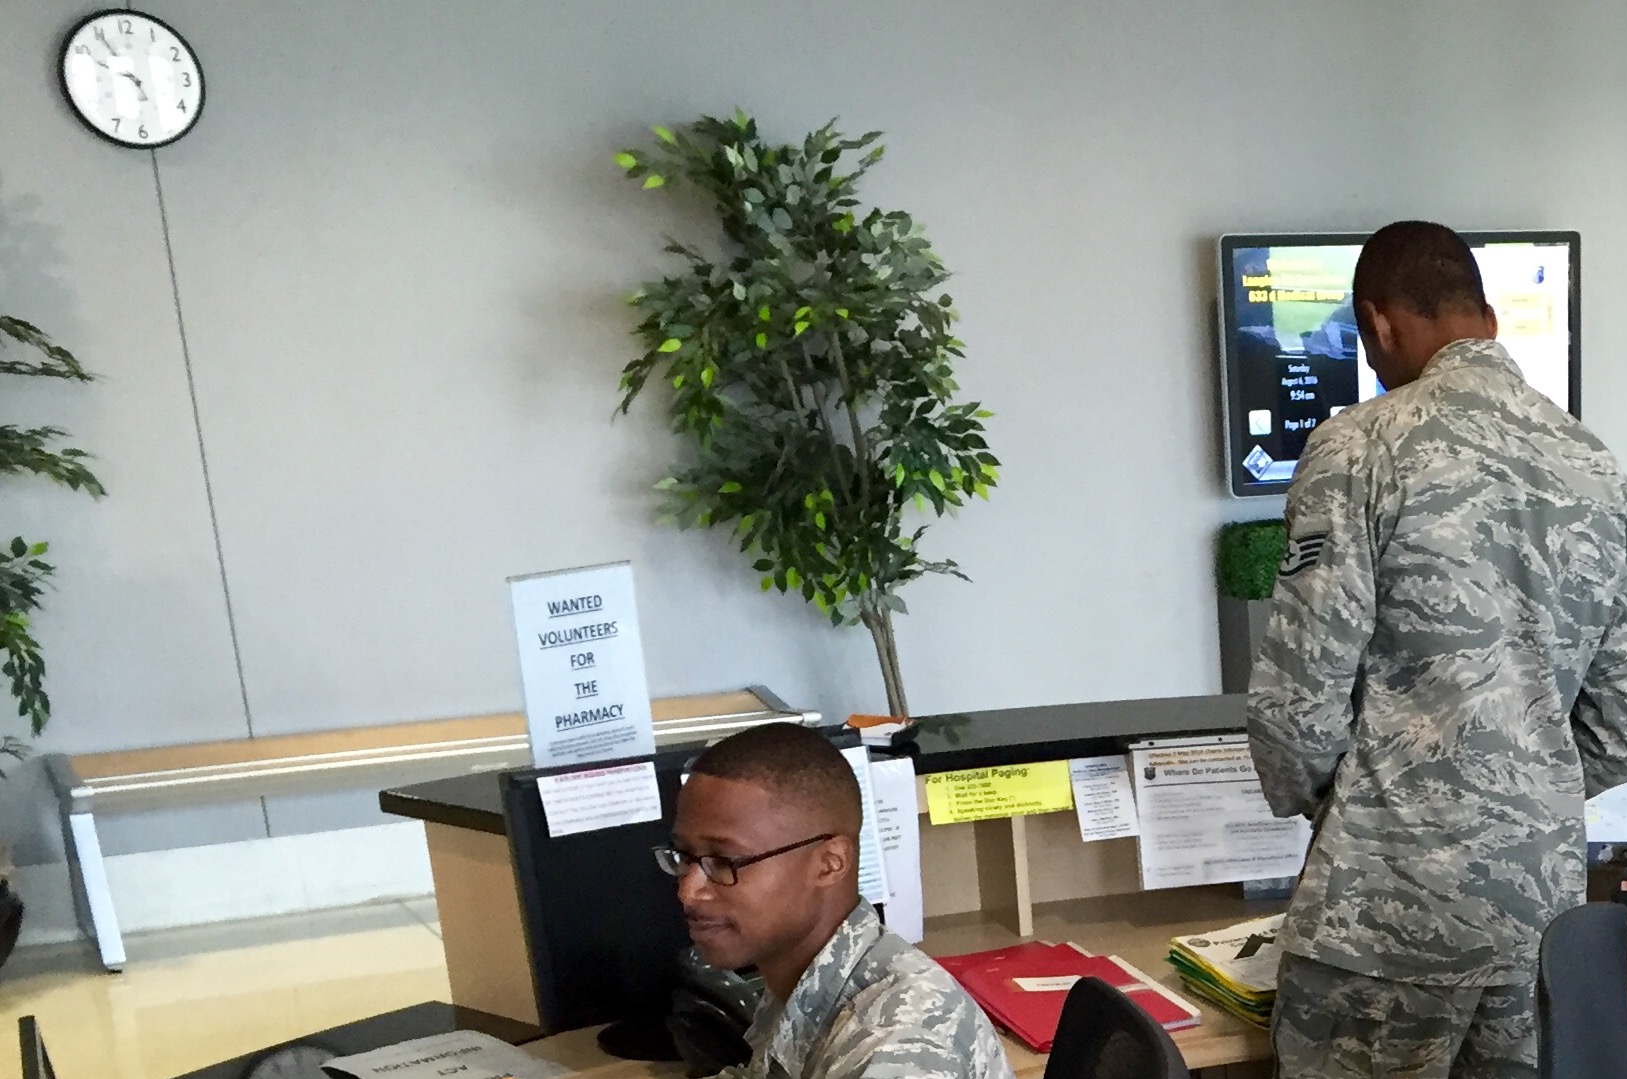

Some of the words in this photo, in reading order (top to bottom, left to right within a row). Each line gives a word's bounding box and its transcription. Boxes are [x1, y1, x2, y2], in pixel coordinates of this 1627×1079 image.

[118, 19, 133, 34] 12
[171, 47, 181, 61] 2
[182, 72, 191, 87] 3
[177, 99, 187, 113] 4
[112, 118, 120, 133] 7
[138, 125, 148, 139] 6
[547, 595, 602, 616] WANTED
[538, 621, 619, 646] VOLUNTEERS
[570, 652, 595, 668] FOR
[574, 680, 598, 697] THE
[555, 704, 624, 729] PHARMACY
[925, 774, 943, 785] For
[945, 769, 989, 783] Hospital
[991, 766, 1030, 780] Paging:
[1163, 768, 1191, 777] Where
[1192, 767, 1205, 776] Do
[1206, 766, 1238, 775] Patients
[437, 1064, 468, 1077] ACT
